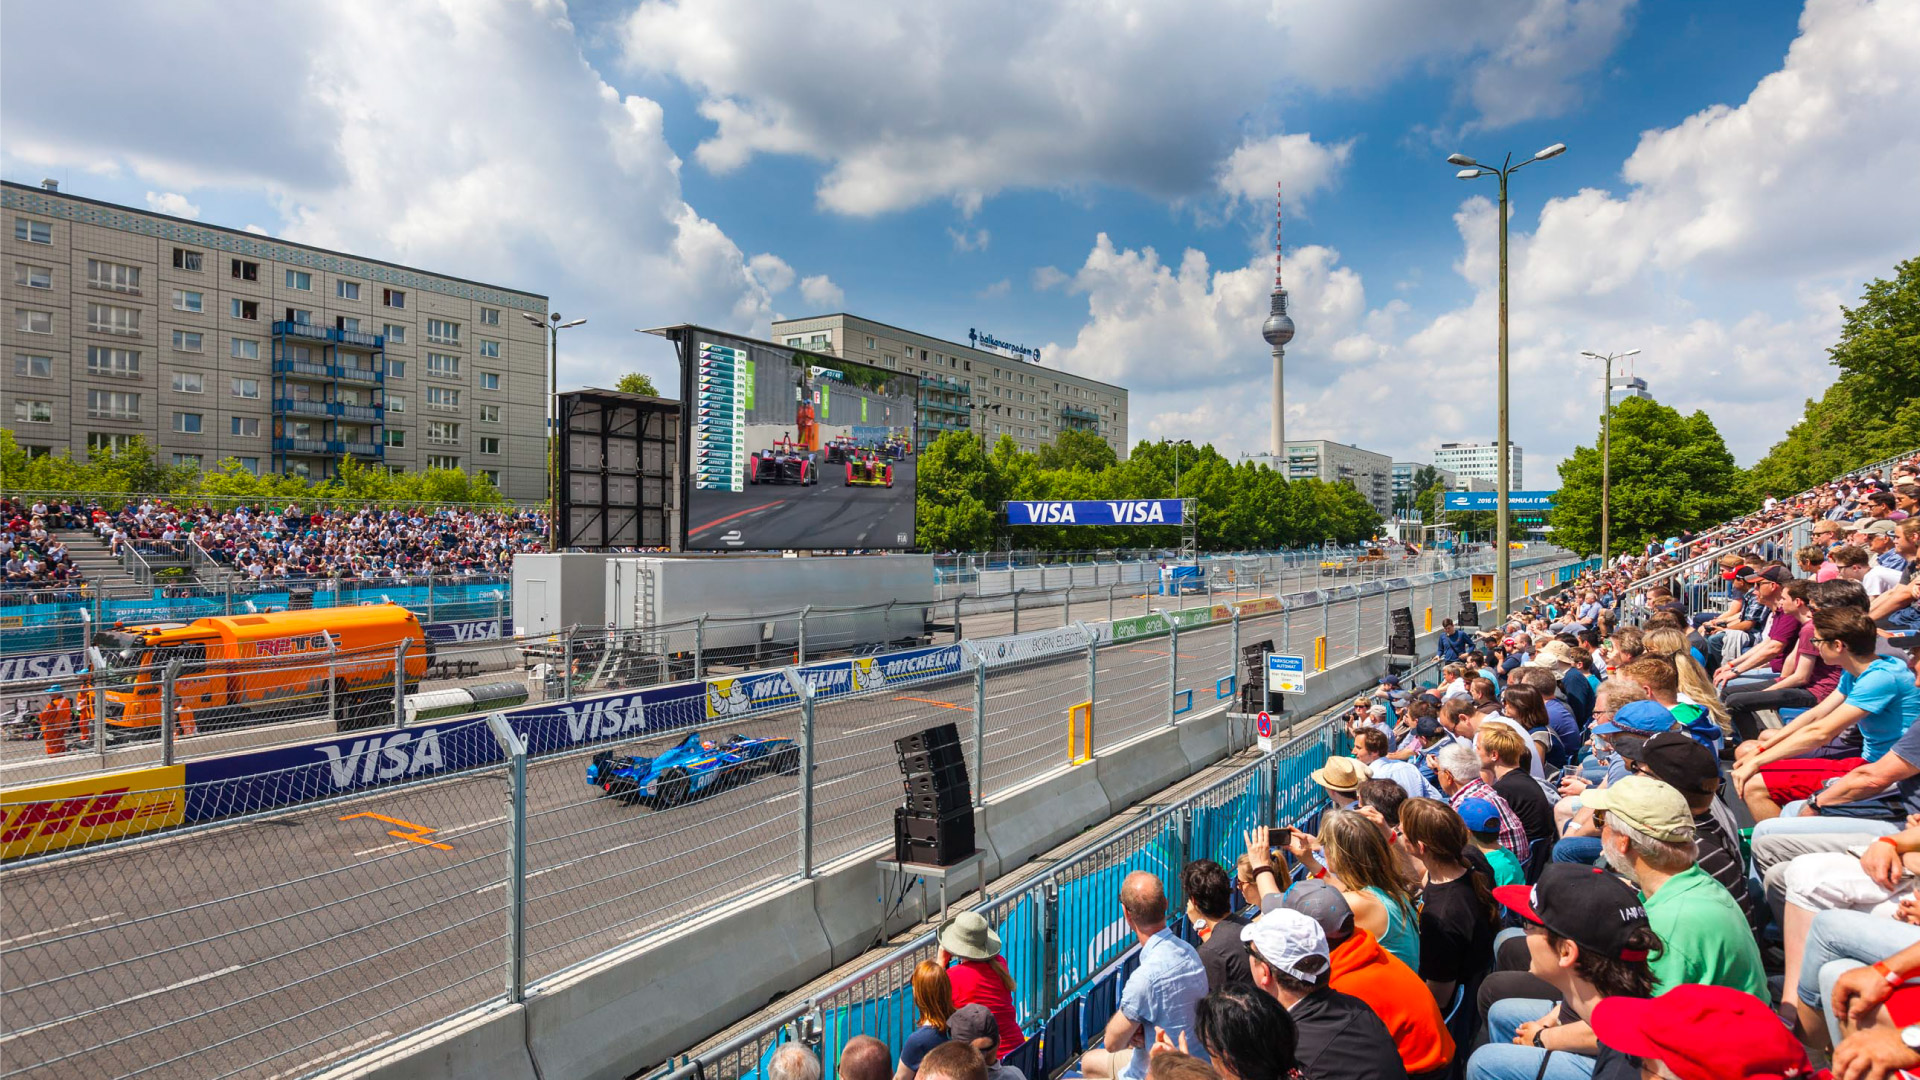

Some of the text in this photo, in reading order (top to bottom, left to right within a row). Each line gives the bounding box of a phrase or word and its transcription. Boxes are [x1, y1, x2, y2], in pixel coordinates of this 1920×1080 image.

[980, 331, 1032, 356] balkancarpodem
[1023, 502, 1164, 523] VISA VISA
[448, 621, 500, 642] VISA
[1118, 621, 1136, 637] enel
[1146, 617, 1162, 632] enel
[1194, 608, 1208, 622] enel
[886, 650, 960, 674] MICHELIN
[558, 696, 646, 741] VISA
[314, 728, 444, 788] VISA
[0, 786, 141, 843] HL
